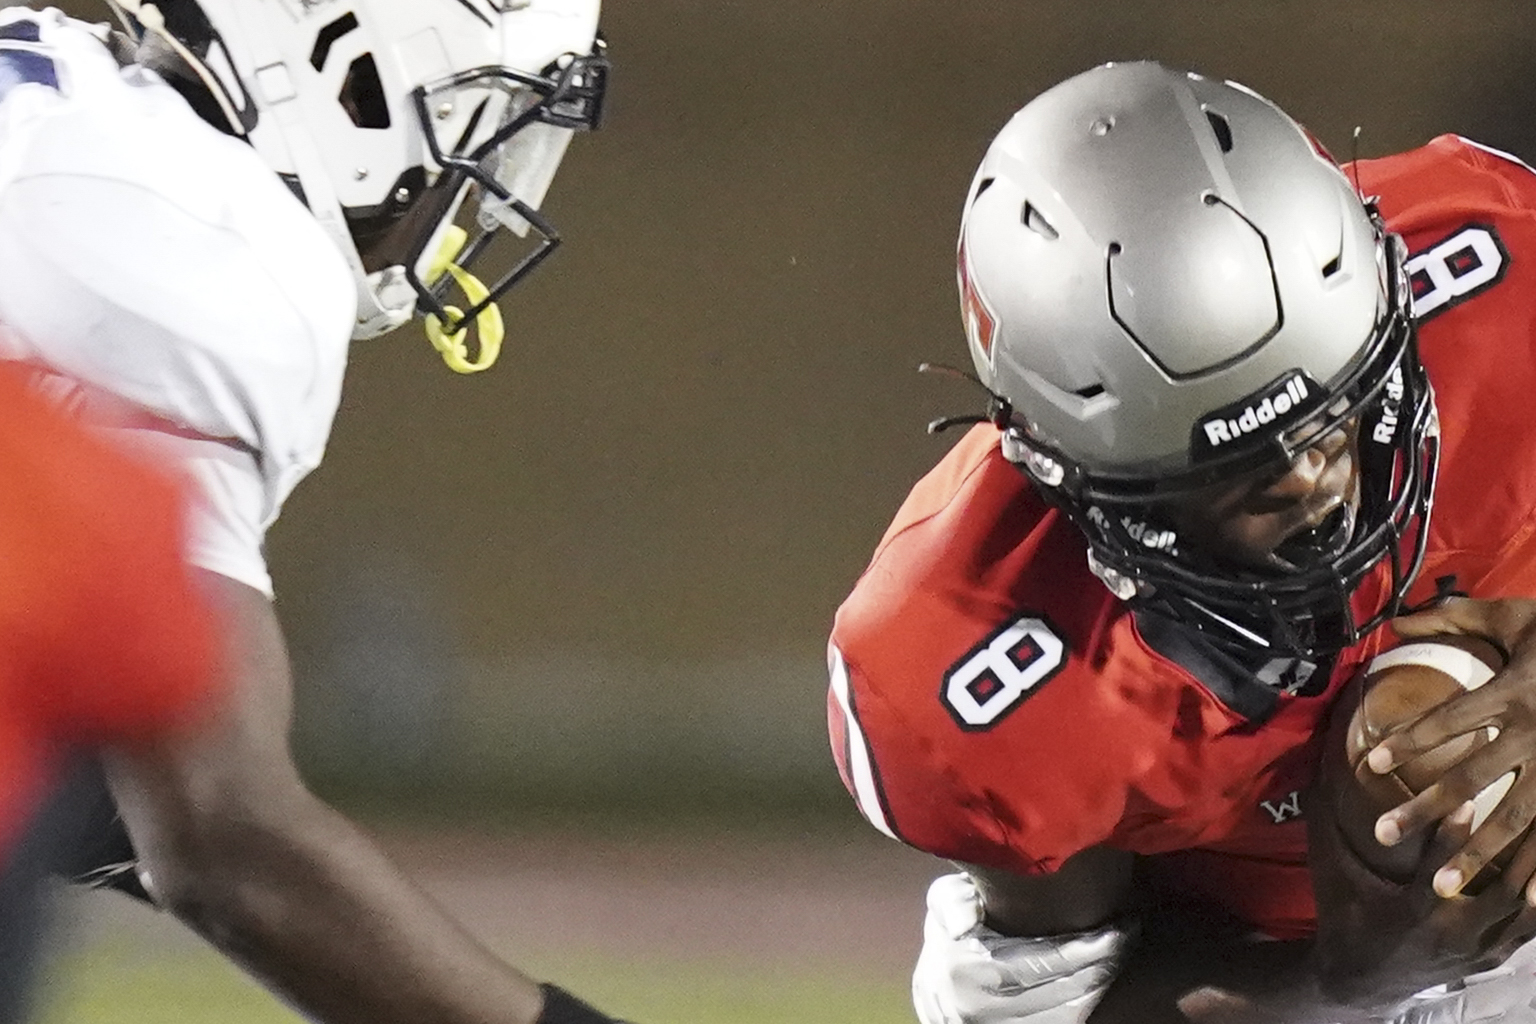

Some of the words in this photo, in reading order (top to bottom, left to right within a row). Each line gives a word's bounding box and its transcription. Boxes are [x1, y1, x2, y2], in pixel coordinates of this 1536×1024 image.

[1402, 225, 1507, 321] 8
[1203, 374, 1309, 446] Riddell
[943, 614, 1068, 729] 8
